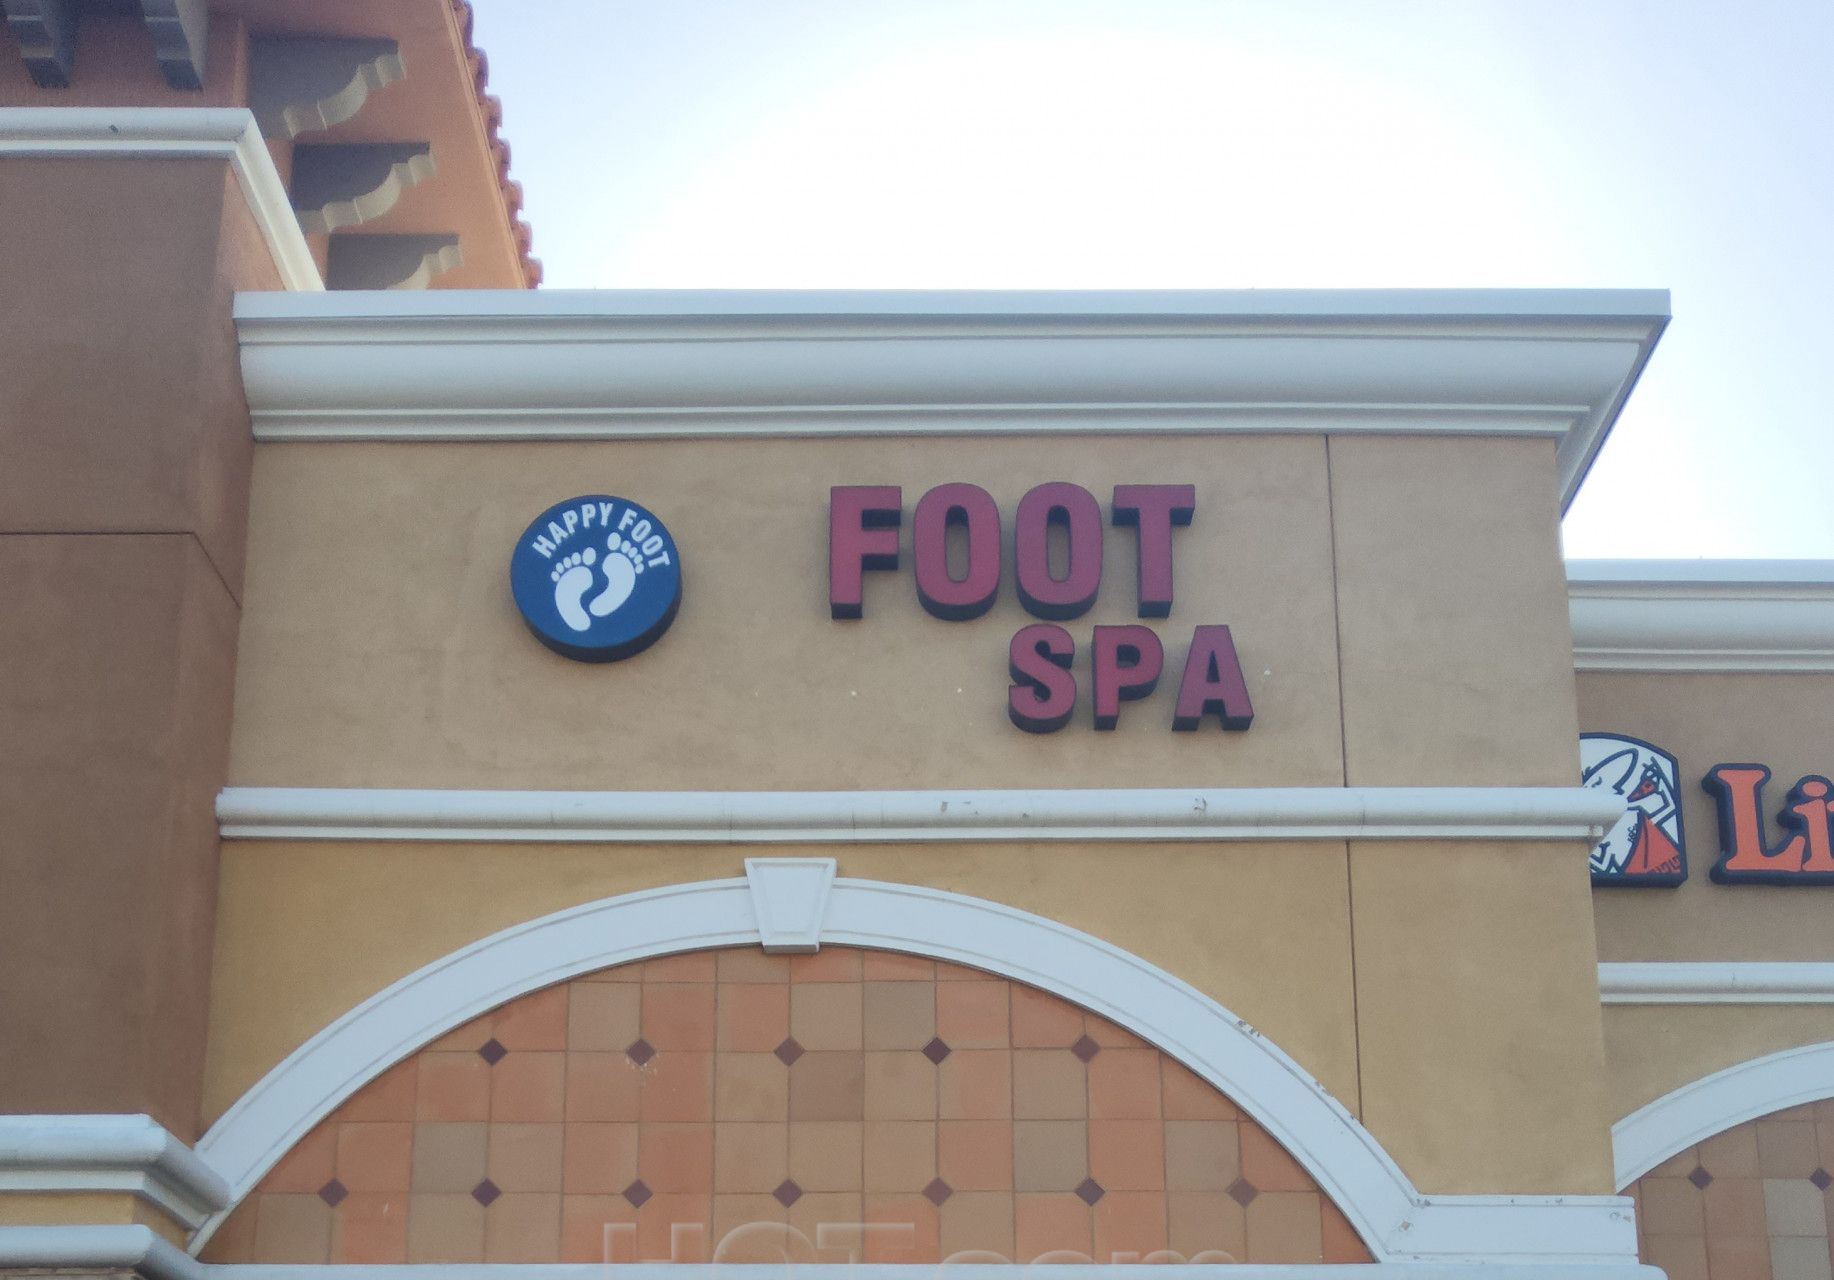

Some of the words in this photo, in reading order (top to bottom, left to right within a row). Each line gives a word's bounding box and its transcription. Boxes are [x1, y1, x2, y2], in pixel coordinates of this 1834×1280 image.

[531, 502, 614, 559] HAPPY
[617, 508, 671, 568] FOOT
[829, 481, 1196, 621] FOOT
[1008, 624, 1254, 734] SPA
[1704, 764, 1834, 885] Li
